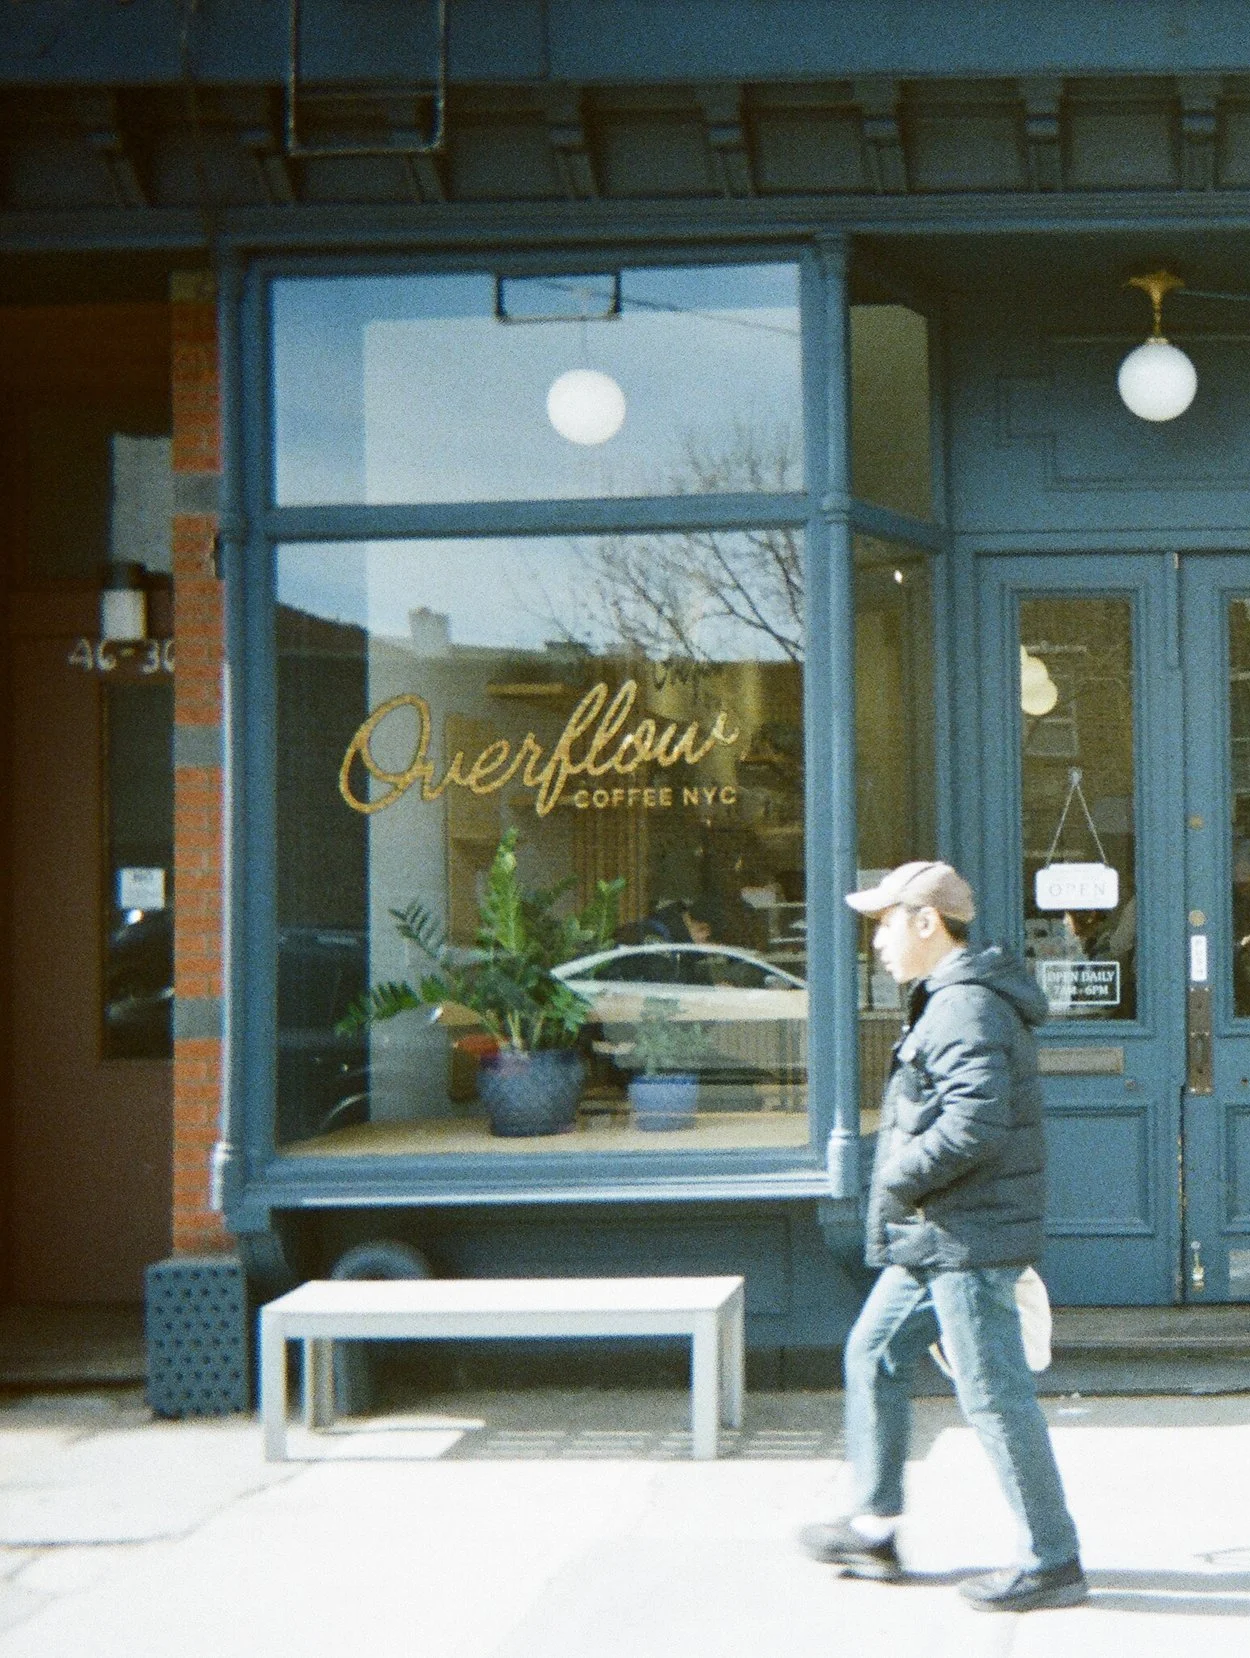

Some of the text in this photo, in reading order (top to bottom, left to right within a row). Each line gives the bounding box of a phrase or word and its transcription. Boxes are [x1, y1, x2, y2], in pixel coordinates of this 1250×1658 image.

[339, 679, 739, 816] Overflow
[574, 786, 738, 809] COFFEE NYC
[1048, 882, 1108, 898] OPEN
[1047, 970, 1115, 983] OPEN DAILY
[1084, 984, 1109, 996] 6PM
